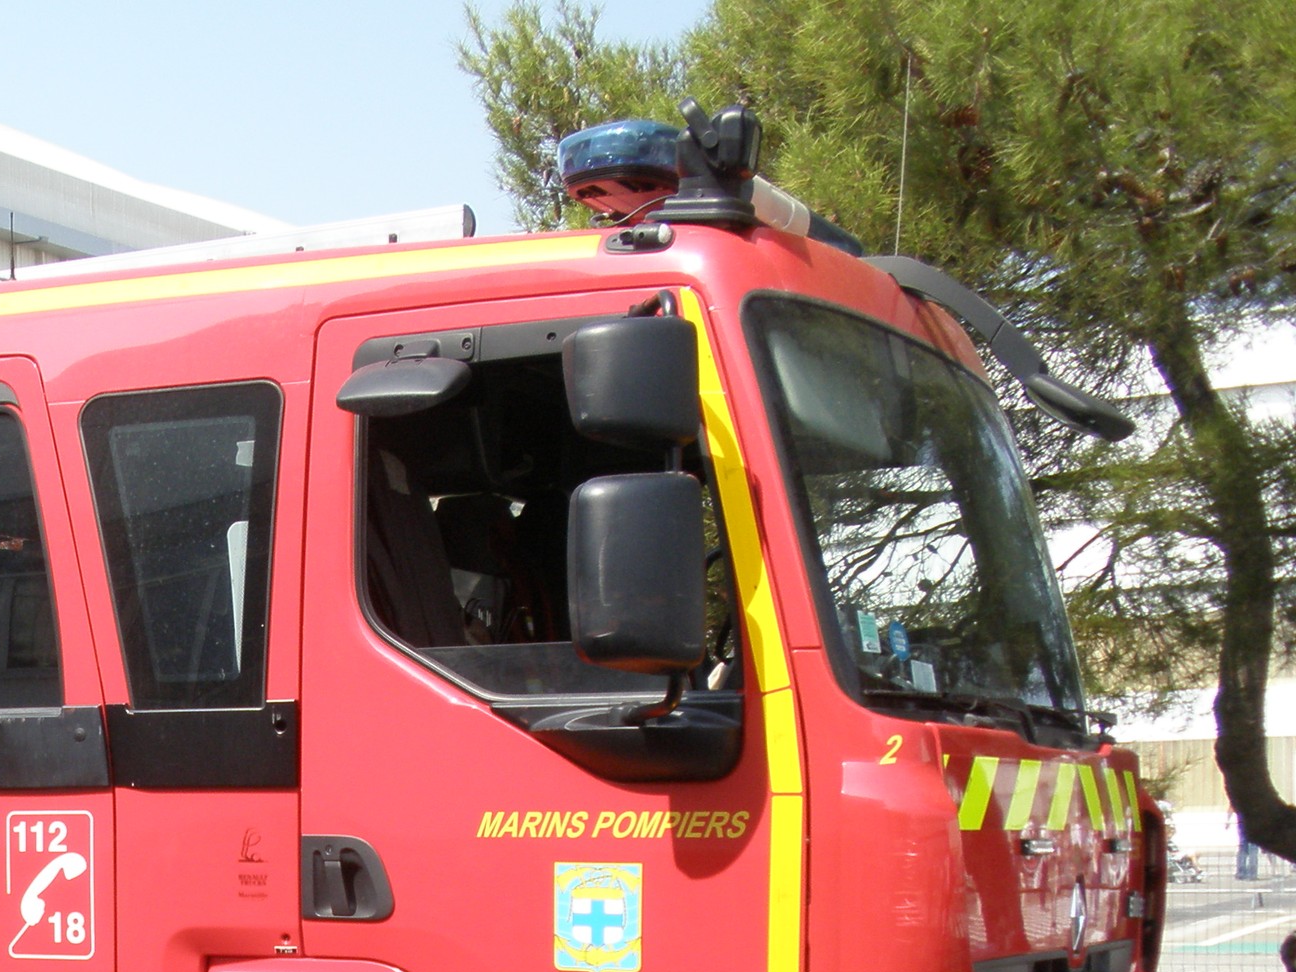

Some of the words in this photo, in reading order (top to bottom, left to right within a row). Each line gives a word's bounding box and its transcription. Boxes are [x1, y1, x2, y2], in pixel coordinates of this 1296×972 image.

[879, 735, 903, 765] 2
[13, 821, 68, 853] 112
[476, 810, 588, 838] MARINS
[591, 811, 750, 839] POMPIERS
[48, 911, 86, 945] 18
